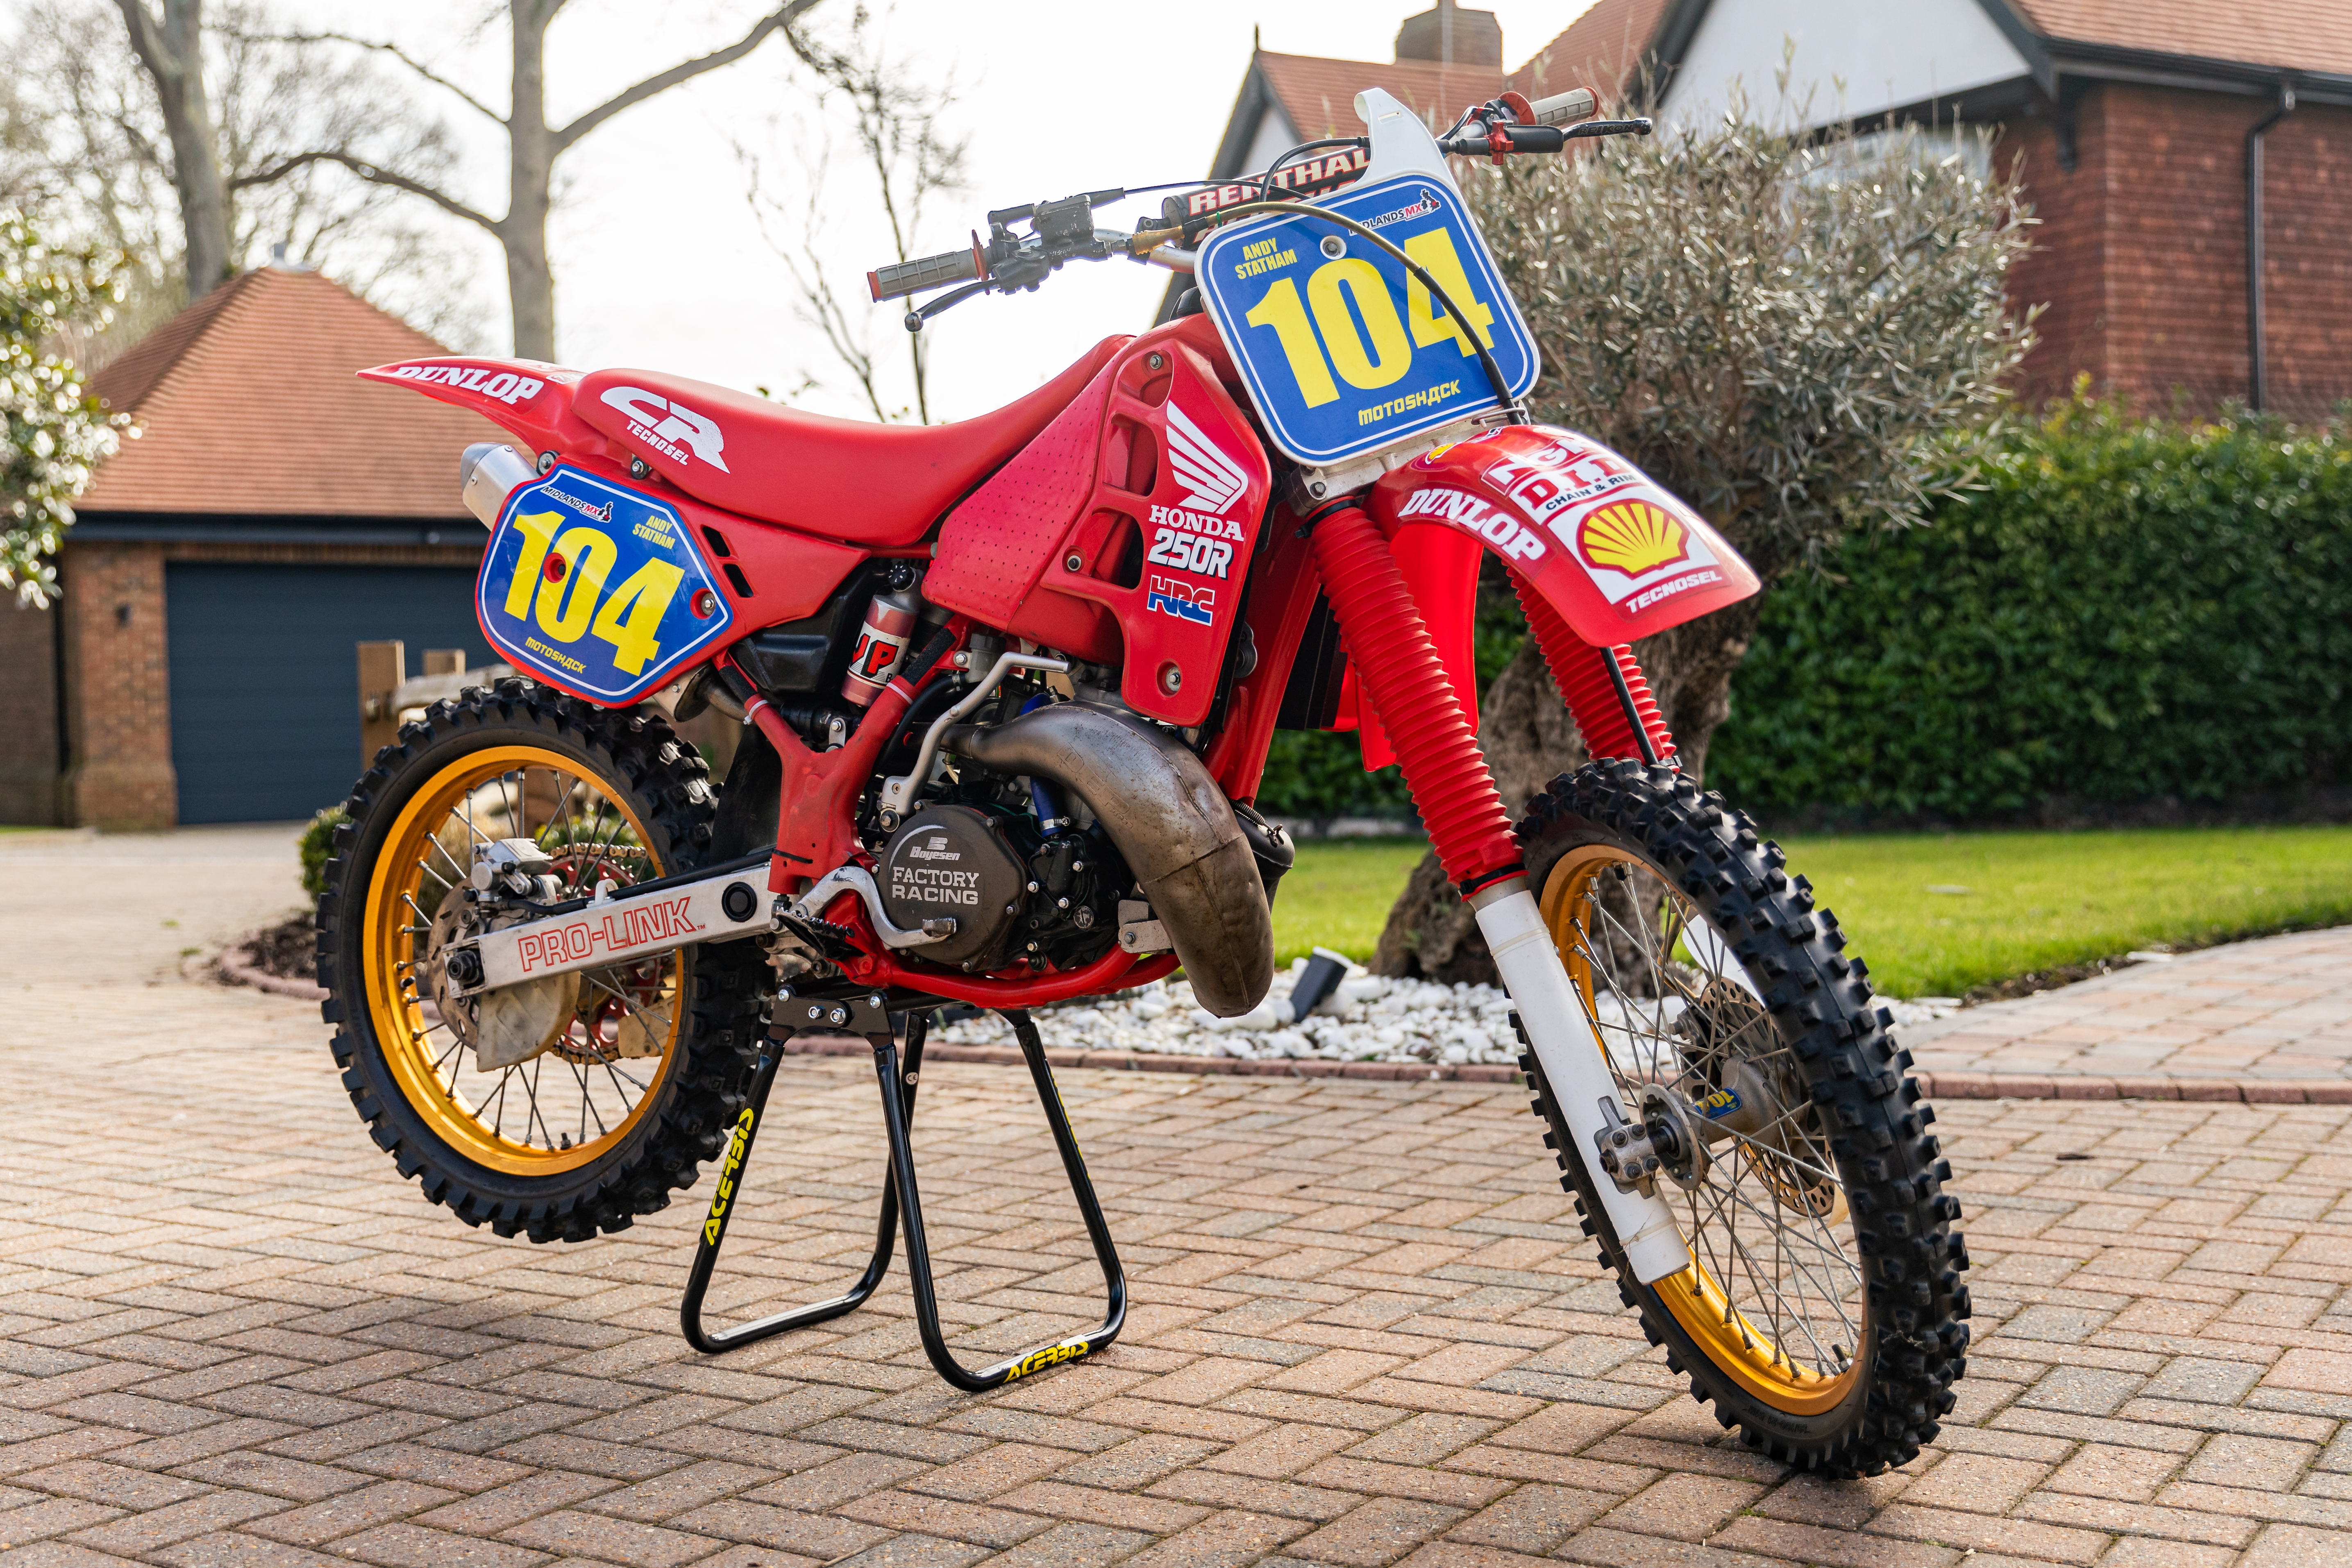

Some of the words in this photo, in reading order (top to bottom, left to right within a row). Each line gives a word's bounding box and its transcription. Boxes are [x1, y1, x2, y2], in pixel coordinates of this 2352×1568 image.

[1578, 124, 1633, 135] REIKON
[1189, 149, 1370, 216] RENTHAL
[1235, 250, 1297, 280] STATHAM
[1243, 238, 1278, 261] ANDY
[1245, 227, 1494, 409] 104
[390, 366, 544, 405] DUNLOP
[600, 386, 731, 474] CR
[625, 419, 688, 465] TECNOSEL
[1546, 488, 1591, 511] CHAIN
[1608, 474, 1636, 485] RIM
[632, 523, 676, 549] STATHAM
[645, 515, 673, 533] ANDY
[1149, 505, 1244, 542] HONDA
[1398, 489, 1546, 561] DUNLOP
[1147, 529, 1234, 580] 250R
[504, 510, 686, 677] 104
[1147, 574, 1215, 626] HRC
[1626, 570, 1722, 613] TECNOSEL
[910, 846, 960, 861] Boyesen
[892, 867, 979, 887] FACTORY
[892, 885, 978, 905] RACING
[518, 896, 697, 972] PRO-LINK
